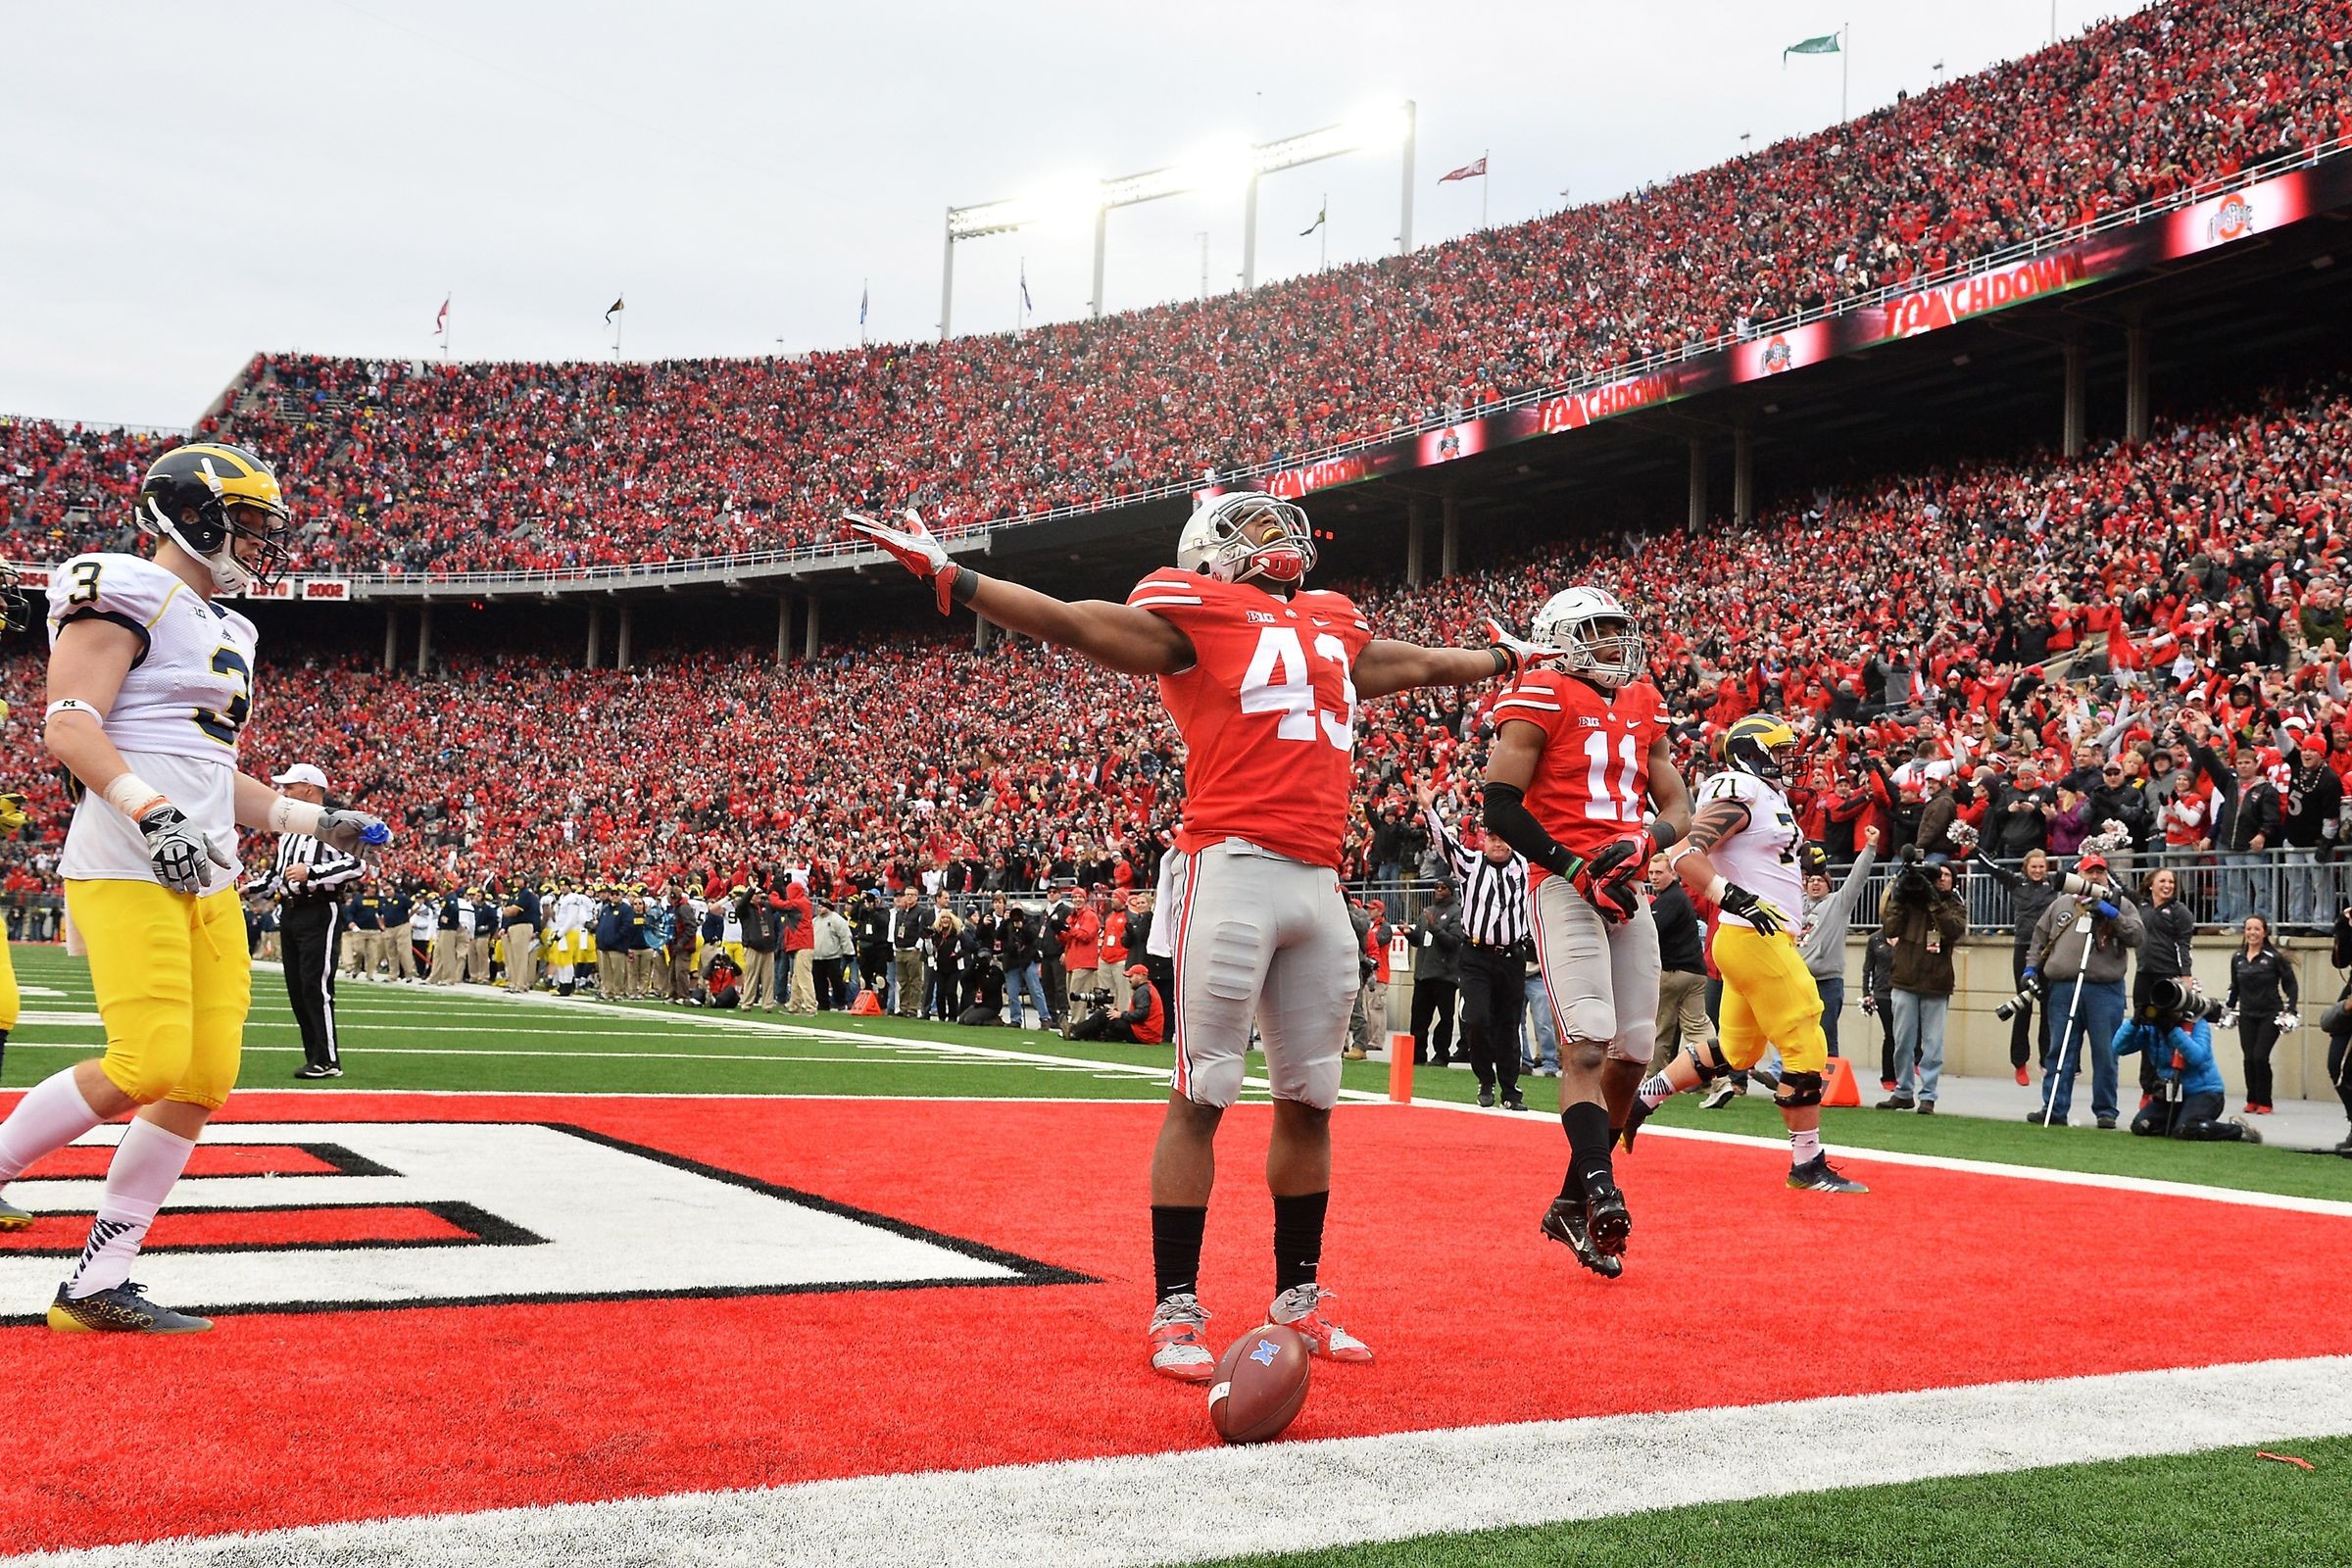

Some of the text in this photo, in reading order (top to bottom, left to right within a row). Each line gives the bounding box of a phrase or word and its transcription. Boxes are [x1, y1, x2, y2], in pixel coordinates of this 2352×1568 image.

[70, 562, 102, 605] 3
[307, 583, 343, 597] 2002
[192, 644, 253, 749] 3
[1240, 626, 1357, 753] 43
[1584, 730, 1642, 822] 11
[1711, 777, 1740, 800] 71
[2287, 789, 2304, 816] 5
[1250, 1339, 1282, 1367] M
